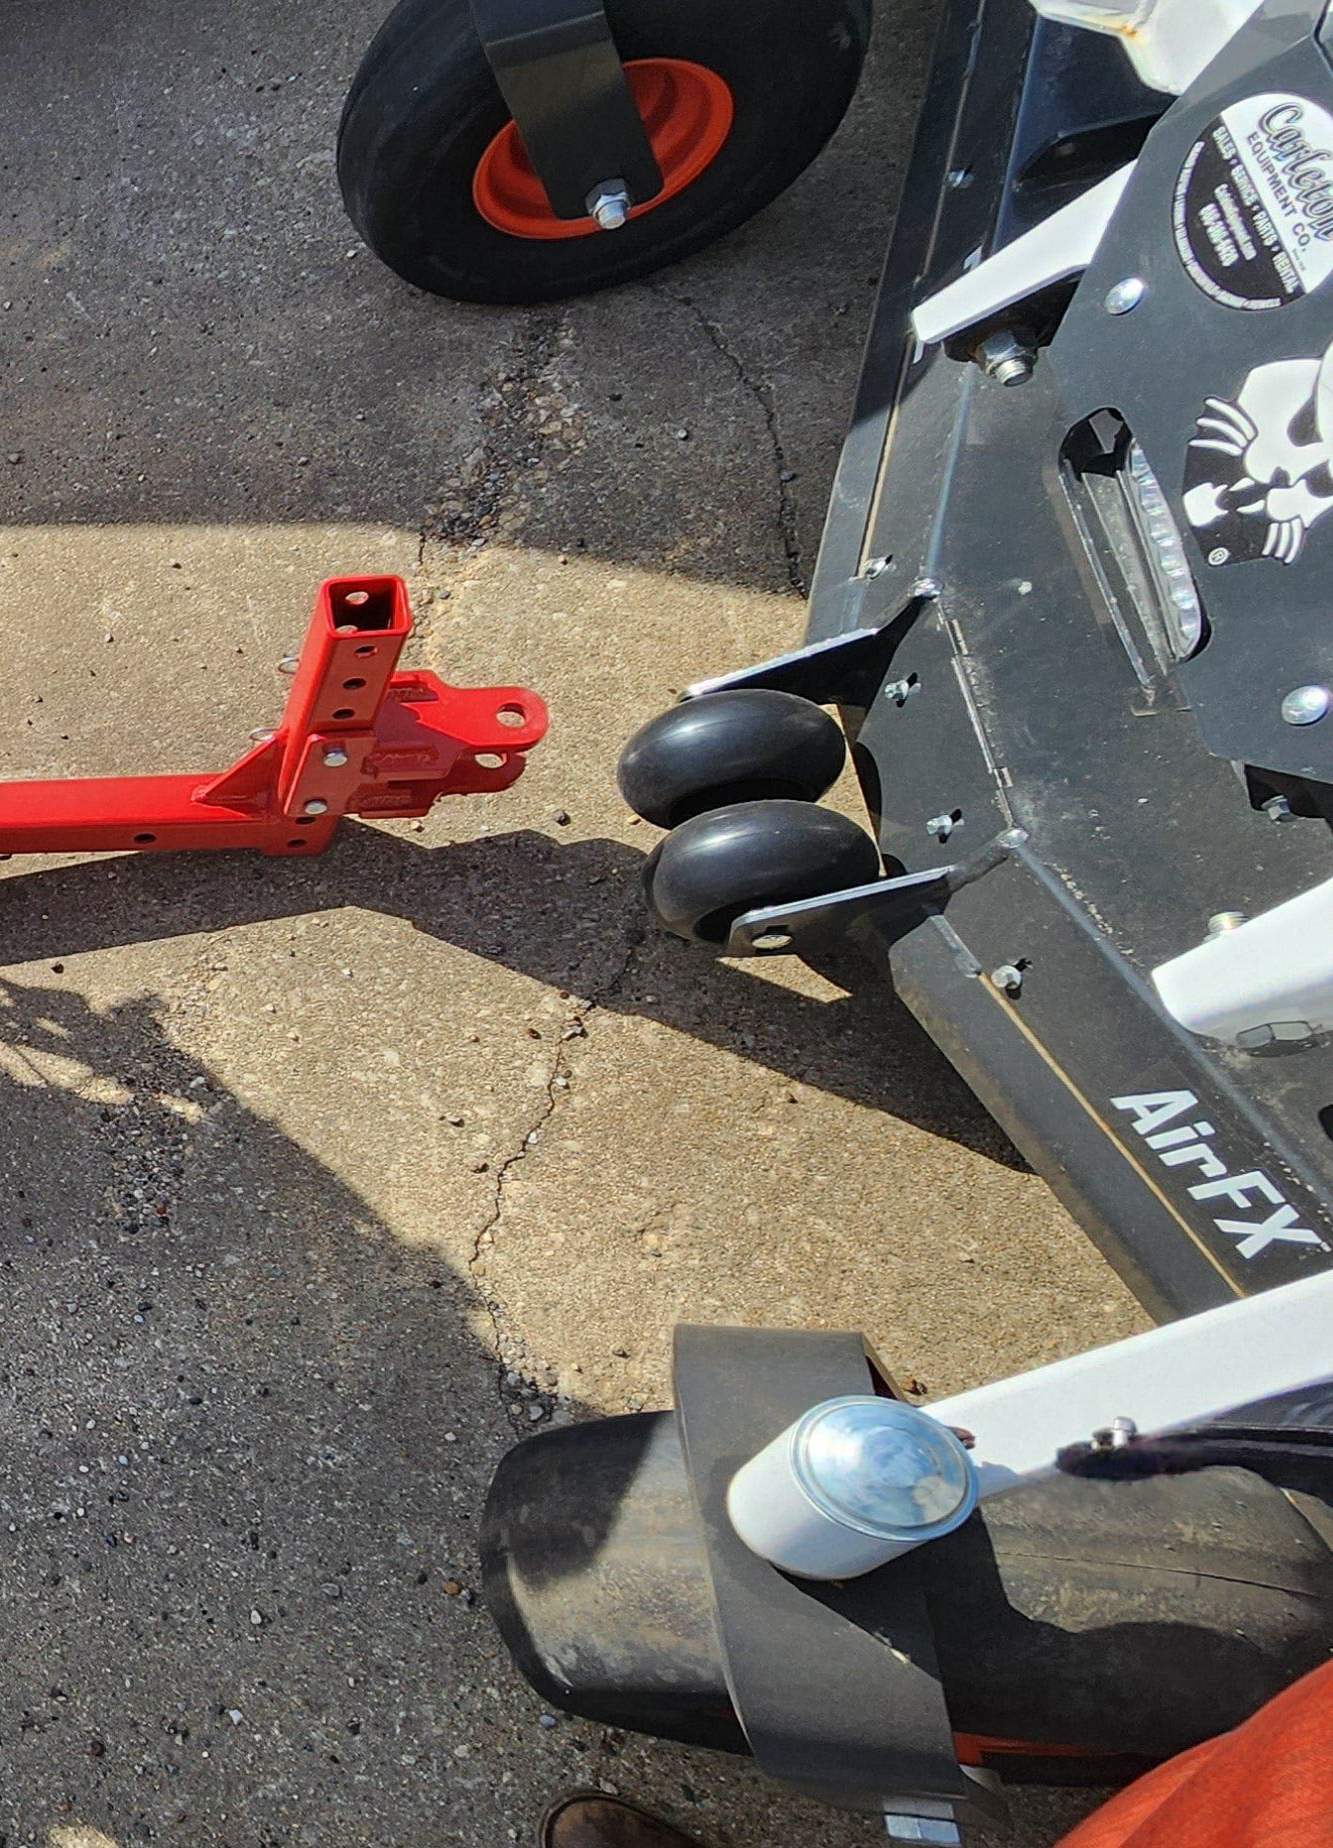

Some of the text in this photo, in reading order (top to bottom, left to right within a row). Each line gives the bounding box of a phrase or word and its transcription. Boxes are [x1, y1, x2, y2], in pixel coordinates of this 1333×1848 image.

[1212, 126, 1236, 160] SALES
[1231, 164, 1258, 206] SERVICE
[1253, 211, 1278, 246] PARTS
[1273, 252, 1300, 293] RENTAL
[1247, 130, 1312, 252] EQUIPMENT CO.
[1258, 102, 1333, 241] Carleton
[1110, 1090, 1323, 1259] AirFX
